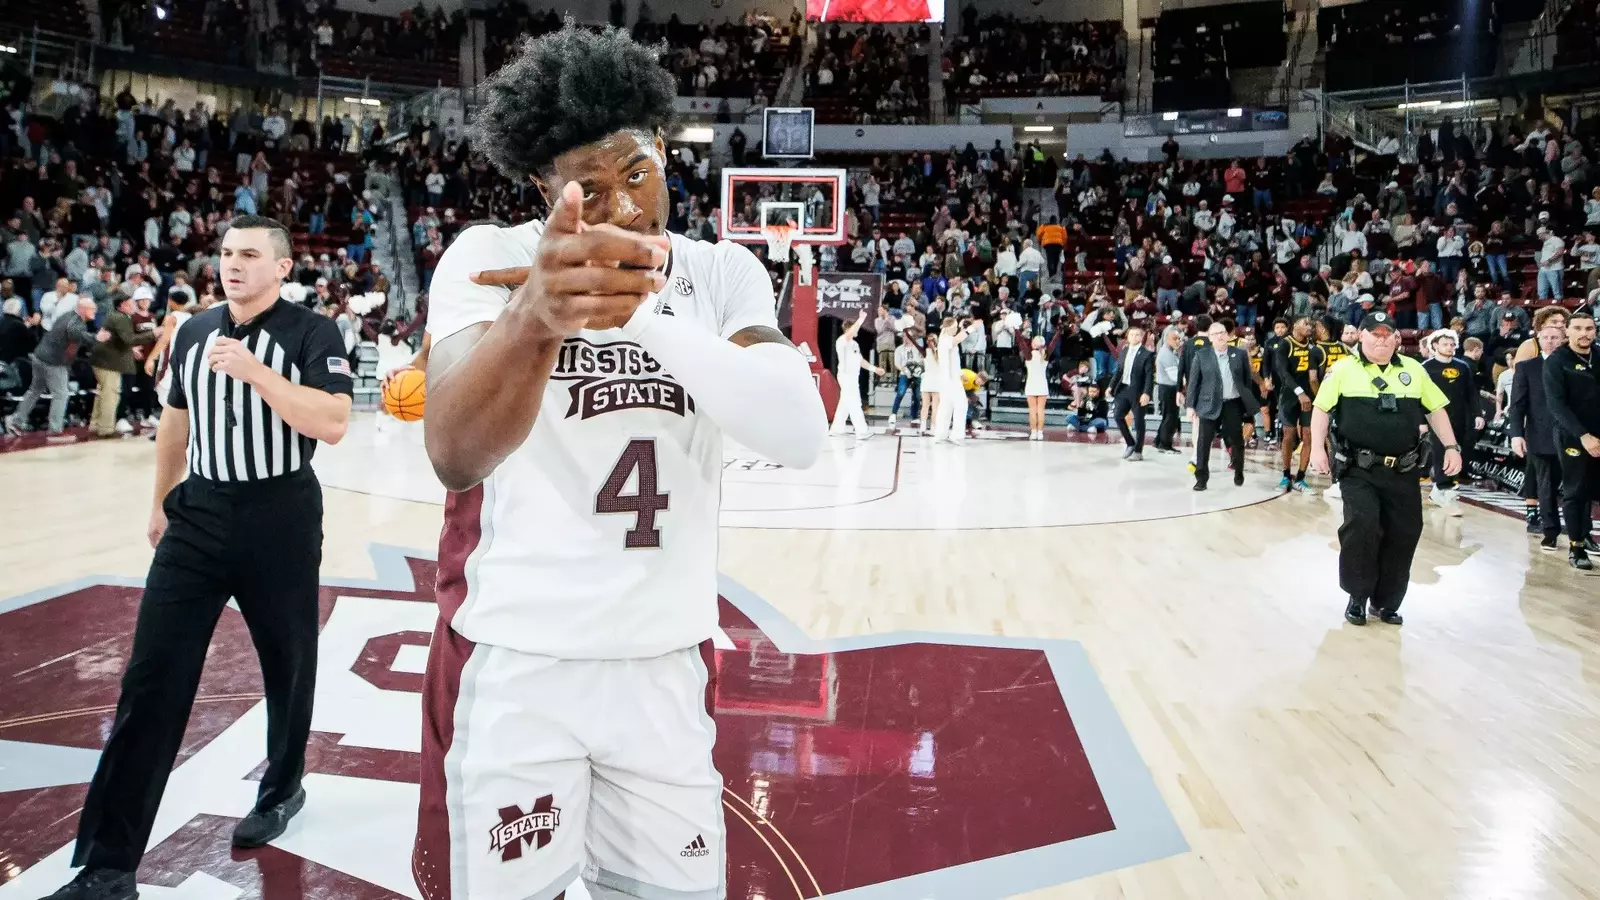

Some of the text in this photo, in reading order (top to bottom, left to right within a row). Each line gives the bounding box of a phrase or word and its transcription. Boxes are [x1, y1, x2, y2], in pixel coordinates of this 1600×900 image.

[675, 277, 693, 295] SEC
[592, 381, 677, 411] STATE
[593, 437, 671, 551] 4
[503, 814, 551, 841] STATE
[680, 849, 710, 857] adidas
